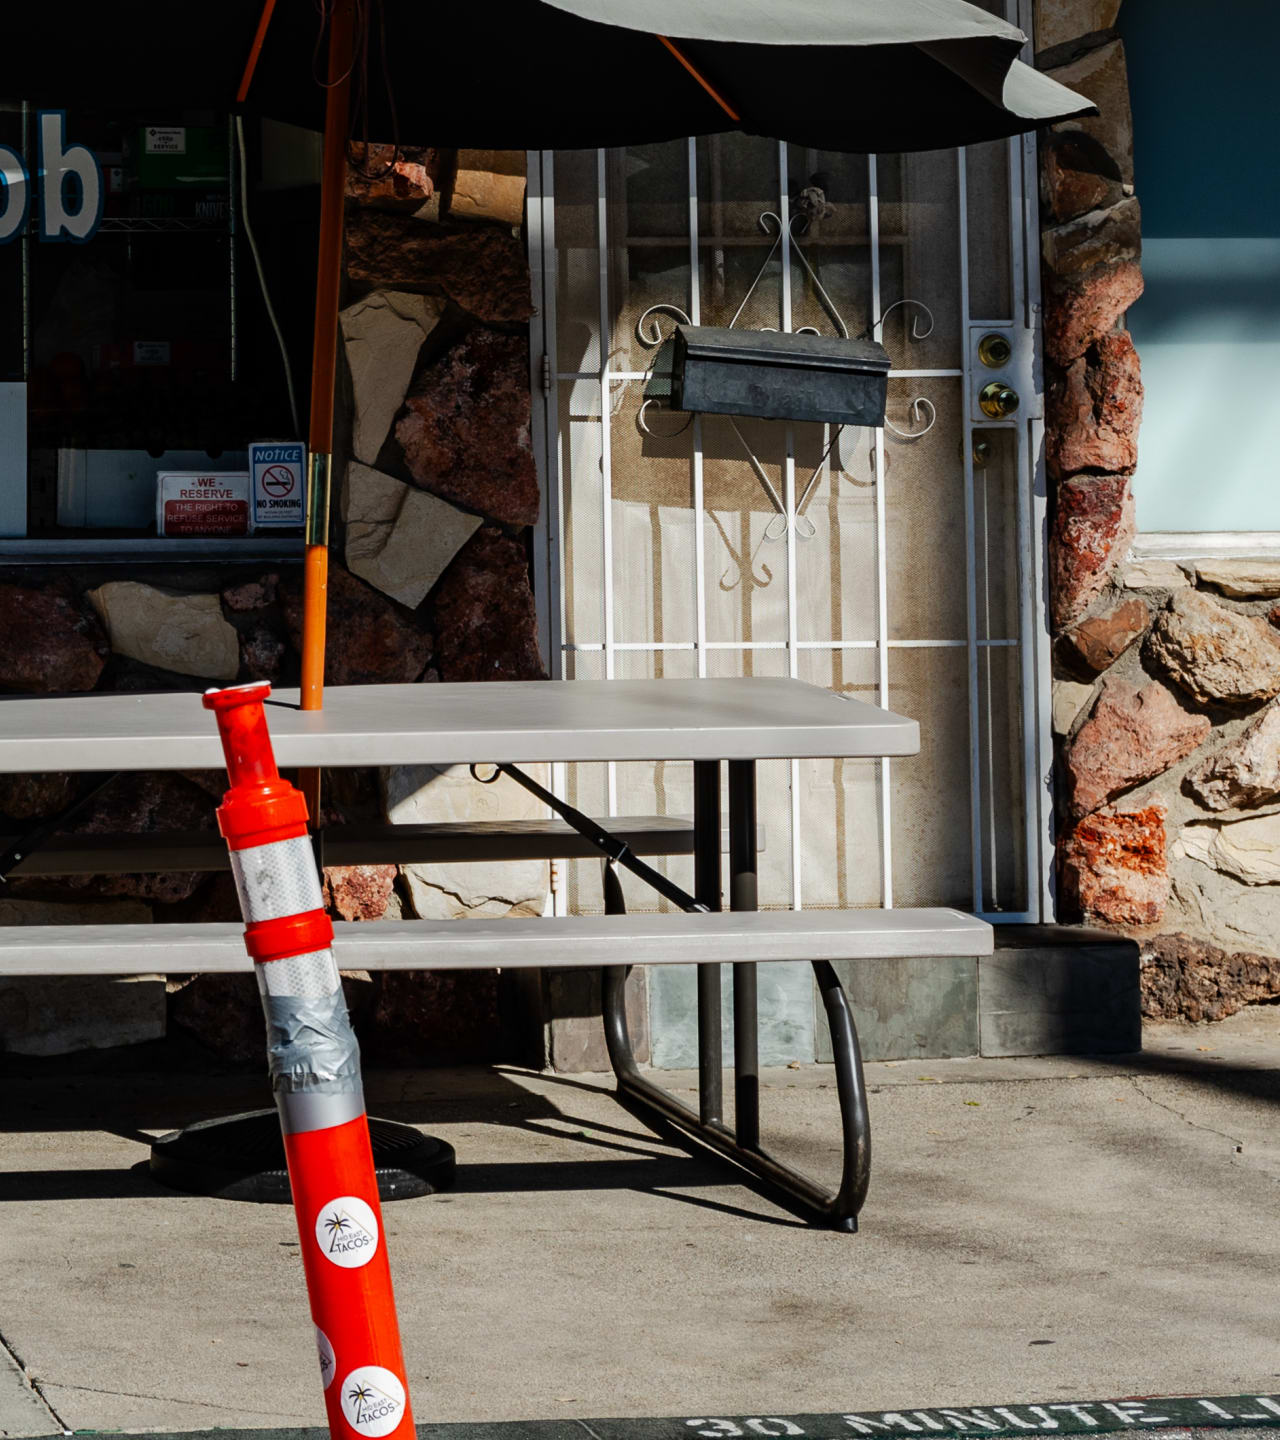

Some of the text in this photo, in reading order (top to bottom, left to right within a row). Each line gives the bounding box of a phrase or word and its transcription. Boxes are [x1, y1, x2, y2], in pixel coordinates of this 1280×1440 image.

[255, 448, 301, 462] NOTICE
[197, 478, 216, 488] WE
[180, 489, 233, 498] RESERVE
[175, 503, 239, 512] THE RIGHT TO
[256, 498, 301, 509] NO SMOKING
[167, 514, 204, 523] REFUSE
[206, 513, 246, 523] SERVICE
[349, 1230, 363, 1239] EAST
[336, 1235, 369, 1253] TACOS
[373, 1398, 388, 1408] EAST
[361, 1403, 395, 1424] TACOS
[685, 1418, 806, 1437] 30
[843, 1401, 1170, 1434] MINUTE
